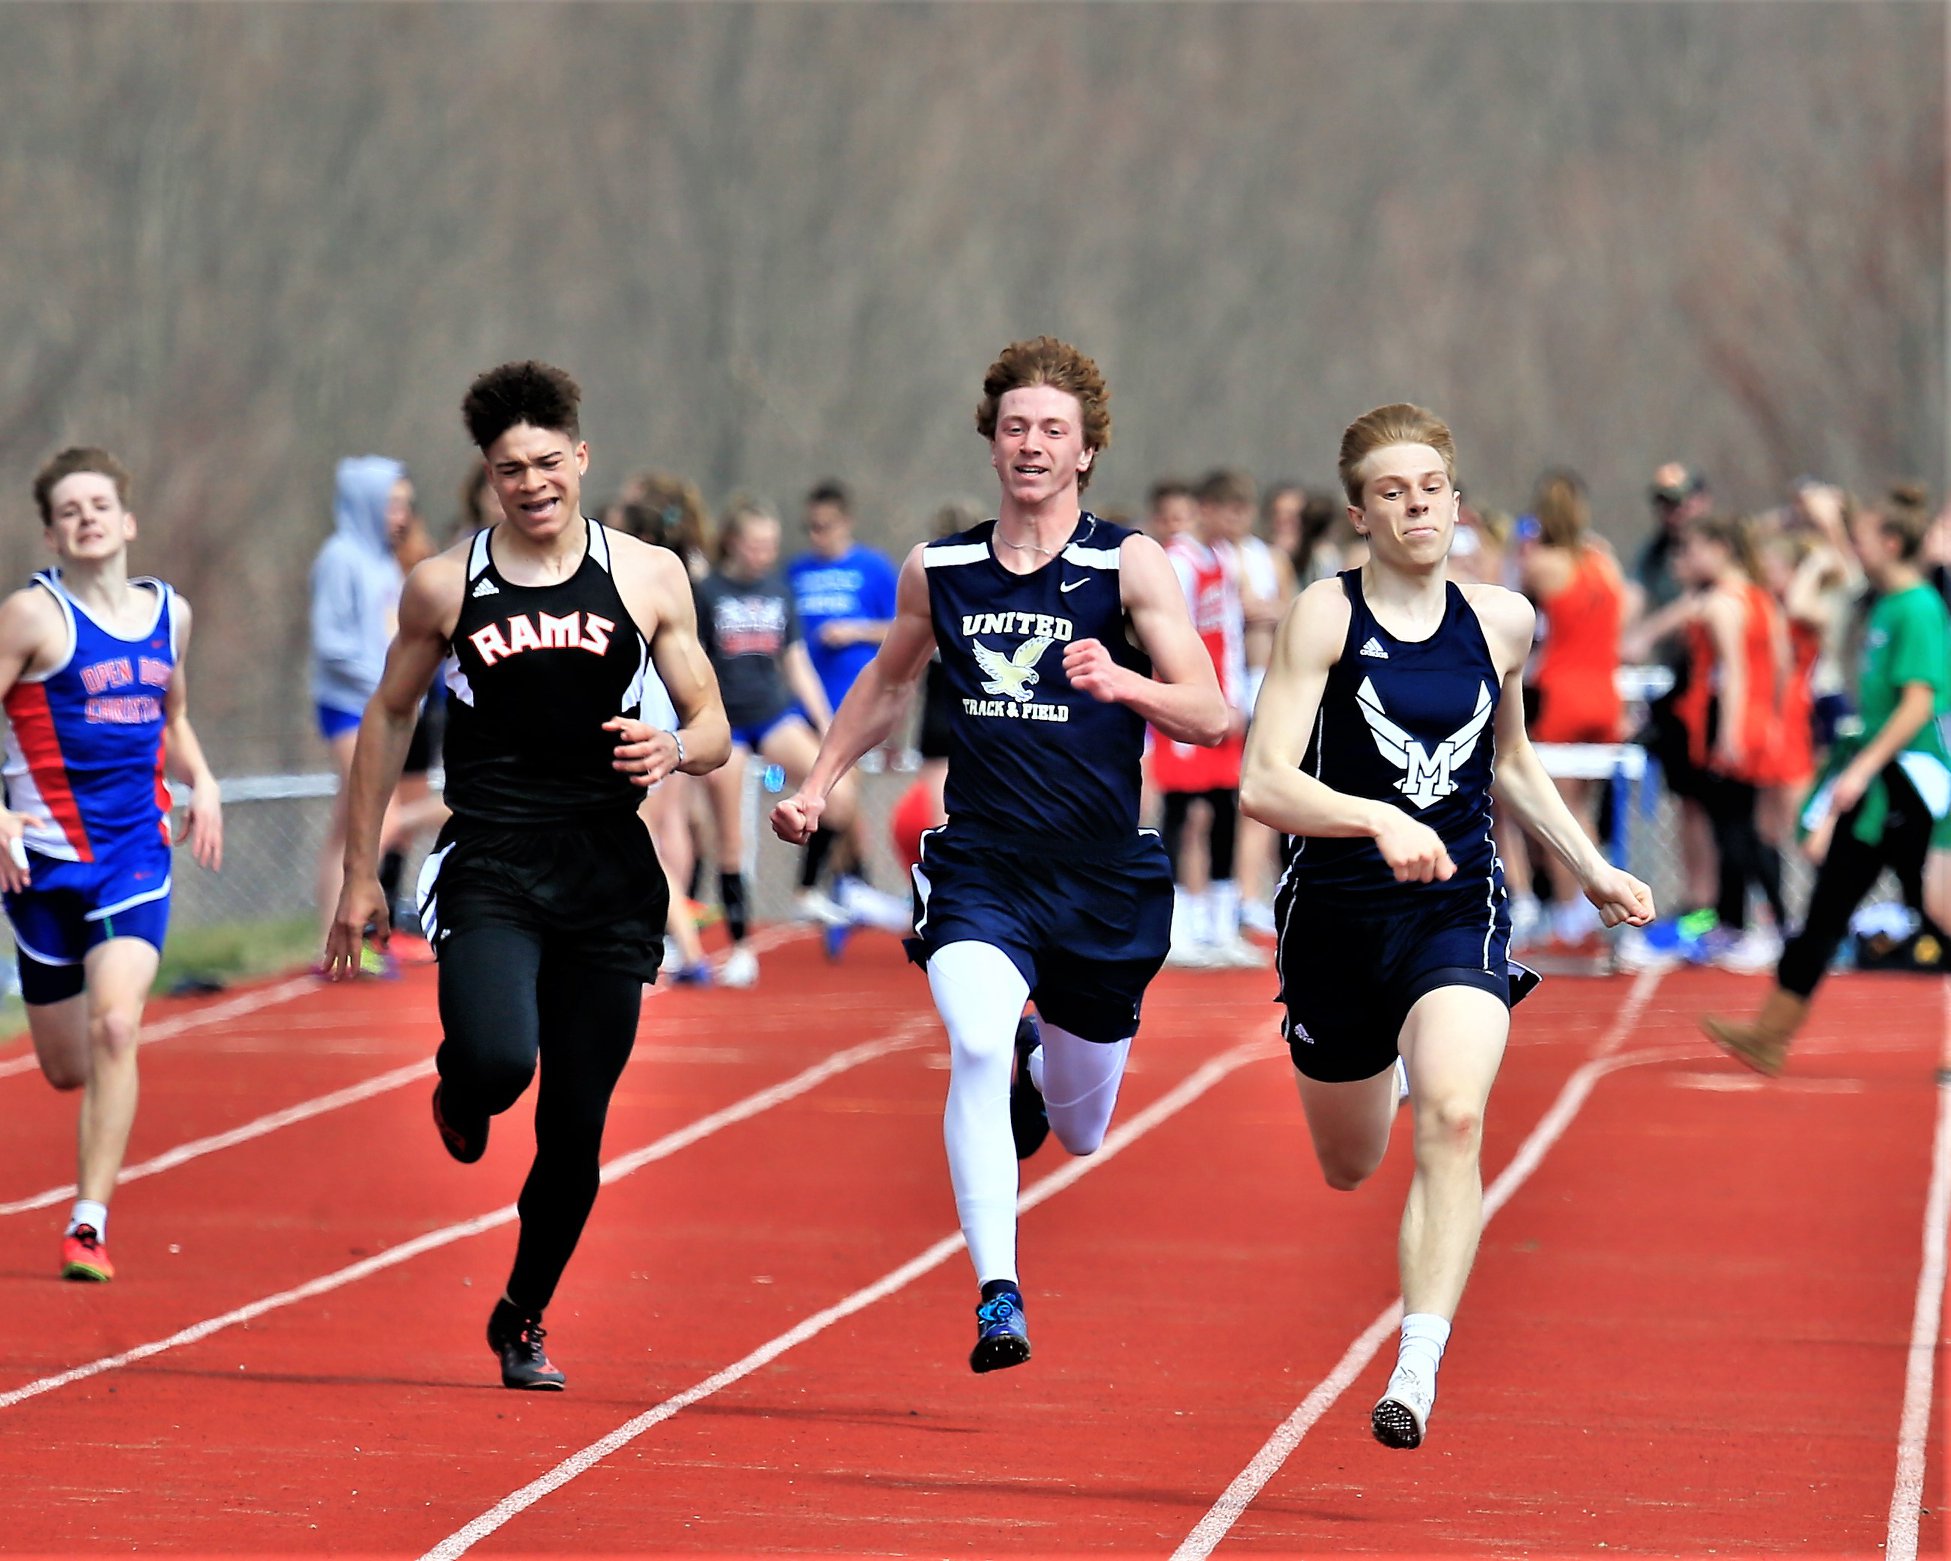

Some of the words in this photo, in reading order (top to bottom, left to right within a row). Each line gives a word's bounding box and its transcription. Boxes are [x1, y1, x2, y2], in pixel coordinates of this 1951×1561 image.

[468, 610, 616, 667] RAMS
[962, 611, 1073, 642] UNITED
[79, 656, 134, 695] OPEN
[962, 698, 1005, 717] TRACK
[1006, 701, 1020, 718] &
[1021, 703, 1069, 722] FIELD
[1401, 741, 1456, 796] M
